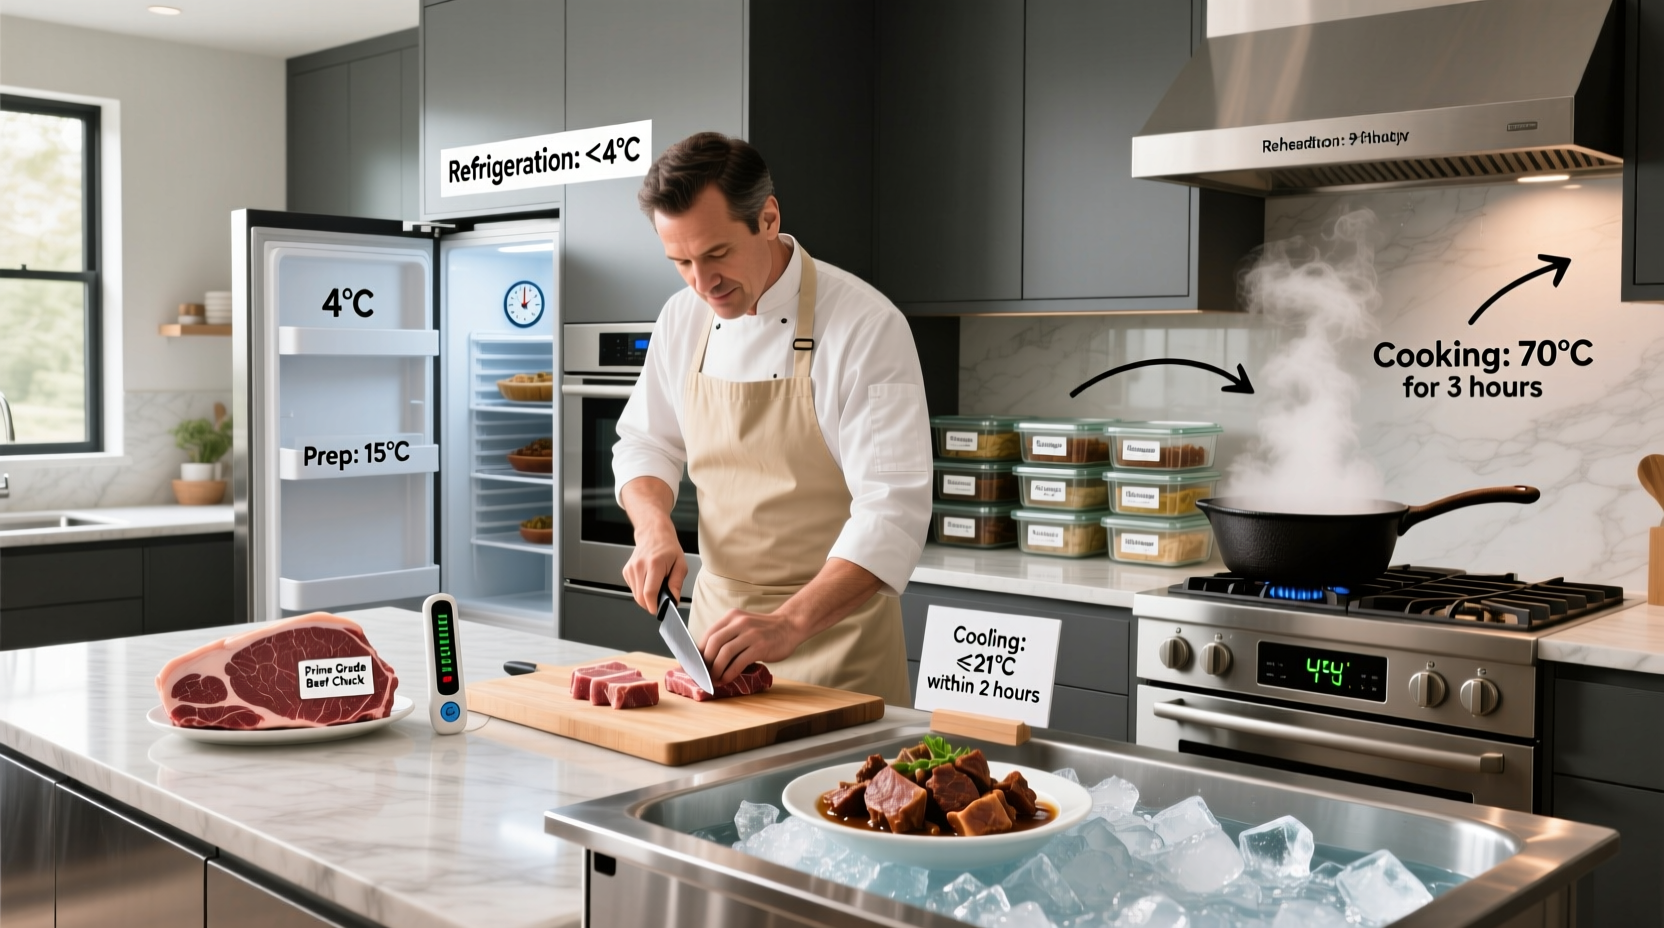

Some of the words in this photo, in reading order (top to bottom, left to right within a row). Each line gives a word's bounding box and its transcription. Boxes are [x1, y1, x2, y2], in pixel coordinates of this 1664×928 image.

[449, 146, 580, 186] Refrigeration:
[585, 136, 641, 165] <4°C
[953, 625, 1027, 655] Cooling:
[927, 673, 975, 695] within
[978, 679, 990, 697] 2
[992, 680, 1041, 704] hours
